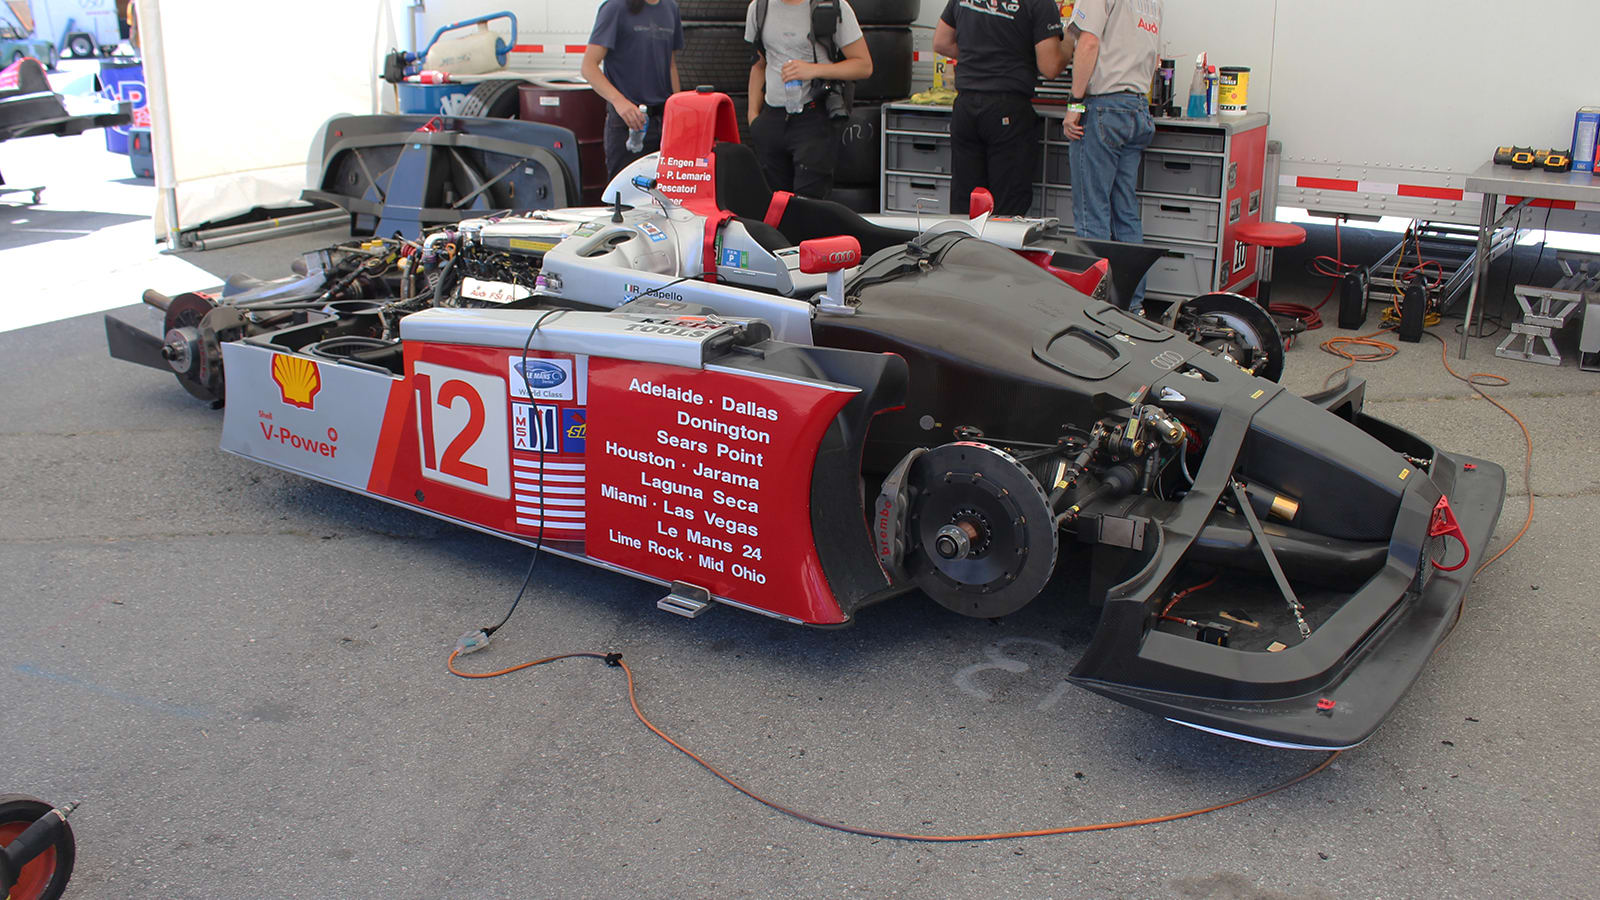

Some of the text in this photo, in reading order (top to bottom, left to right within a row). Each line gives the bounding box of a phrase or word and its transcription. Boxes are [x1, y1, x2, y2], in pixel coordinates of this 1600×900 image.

[666, 171, 674, 180] P.
[676, 171, 711, 181] Lemarie
[667, 157, 694, 168] Engen
[656, 183, 697, 193] Pescatori
[633, 285, 683, 302] R. Capello
[624, 323, 709, 338] TOOLS
[518, 389, 563, 398] Wrld Class
[629, 378, 778, 421] Adelaide Dallas
[258, 410, 273, 420] Shell
[413, 373, 489, 487] 12
[515, 406, 527, 449] IMSA
[677, 411, 770, 444] Donington
[259, 421, 338, 458] V-Power
[656, 430, 763, 467] Sears Point
[605, 440, 759, 490] Houston Jarama
[601, 483, 759, 537] Miami Las Vegas
[641, 472, 759, 514] Laguna Seca
[657, 520, 762, 561] Le Mans 24
[880, 500, 892, 556] brembo
[609, 528, 766, 585] Lime Rock Mid Ohio
